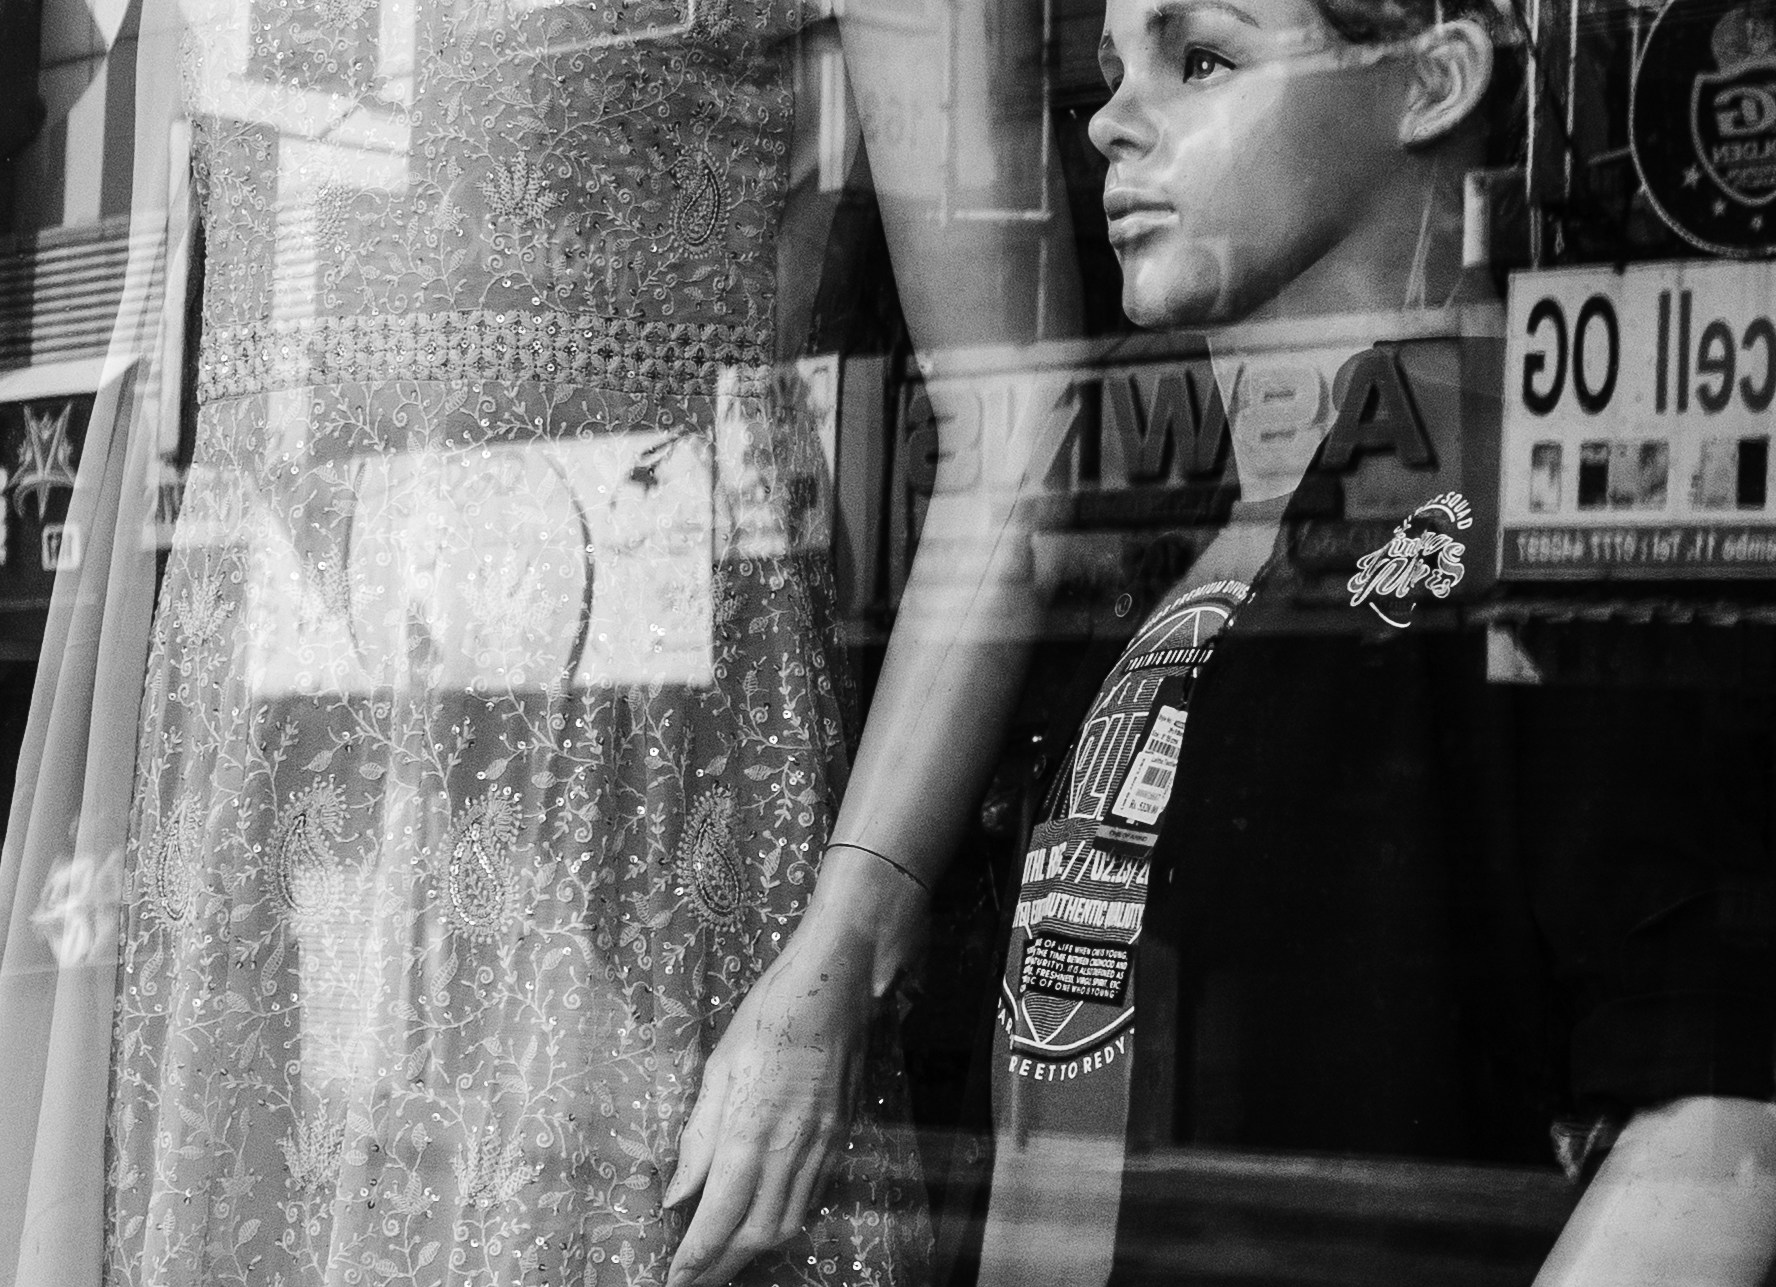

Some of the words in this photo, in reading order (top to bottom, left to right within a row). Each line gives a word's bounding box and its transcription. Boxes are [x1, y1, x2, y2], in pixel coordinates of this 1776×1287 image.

[1441, 491, 1473, 530] SQUAD
[1045, 892, 1107, 929] UTHENTIC
[1060, 1060, 1078, 1082] TO
[1083, 1035, 1126, 1074] REDY
